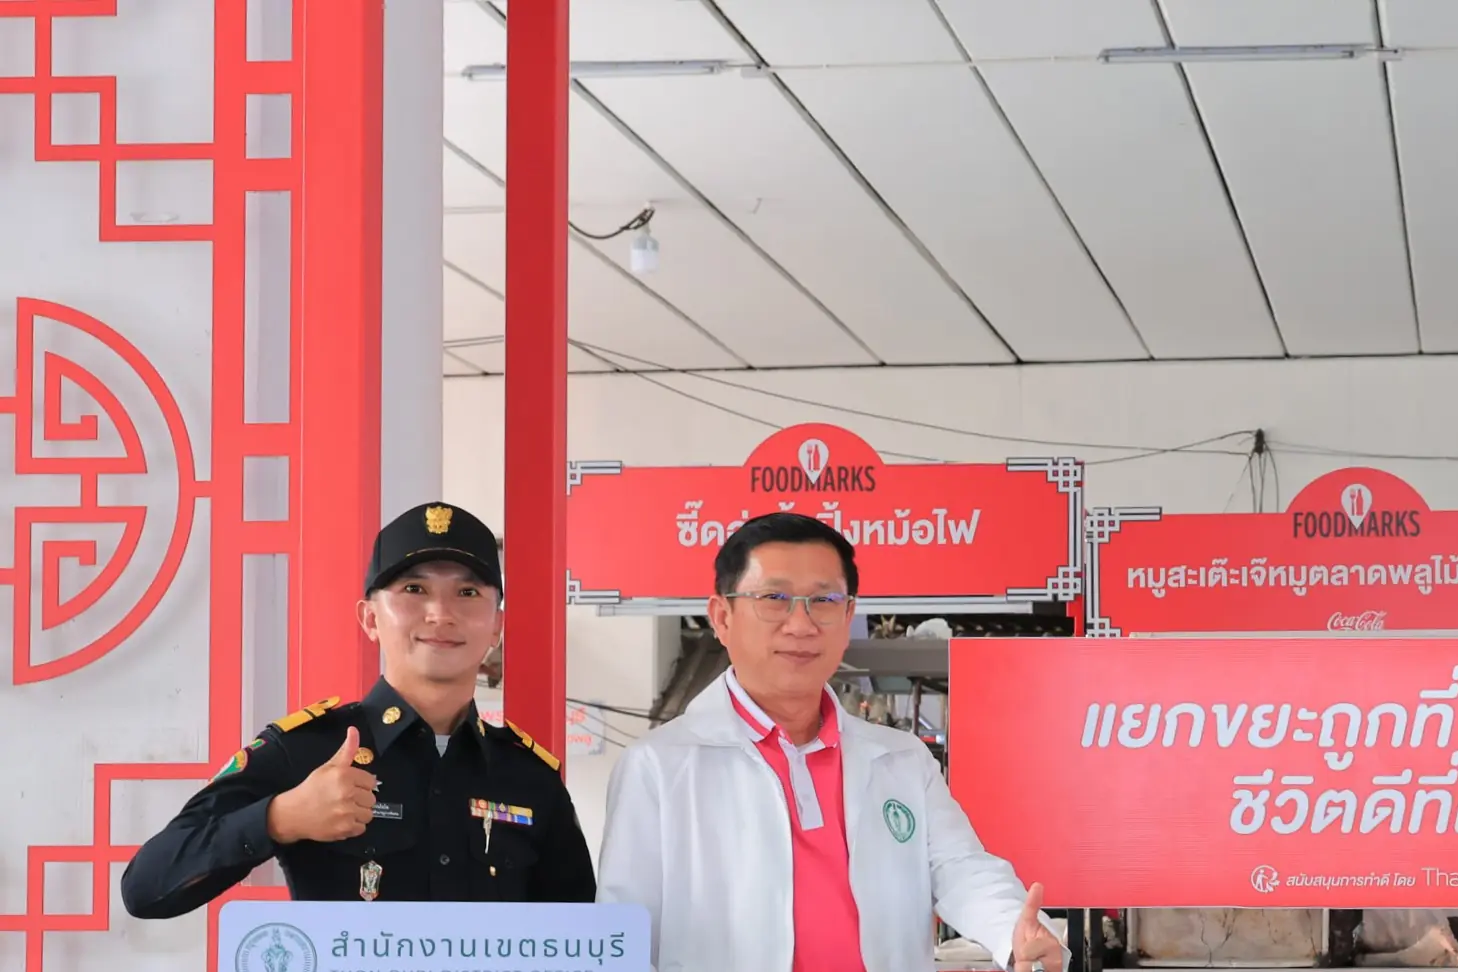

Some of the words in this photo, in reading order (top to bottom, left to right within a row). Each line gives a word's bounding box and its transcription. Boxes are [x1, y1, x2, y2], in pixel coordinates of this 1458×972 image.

[751, 466, 876, 493] FOODMARKS
[1293, 509, 1421, 539] FOODMARKS
[1286, 872, 1391, 890] สนับสนุนการทำดี
[1393, 873, 1416, 887] โดย
[331, 930, 625, 966] สำนักงานเขตธนบุรี
